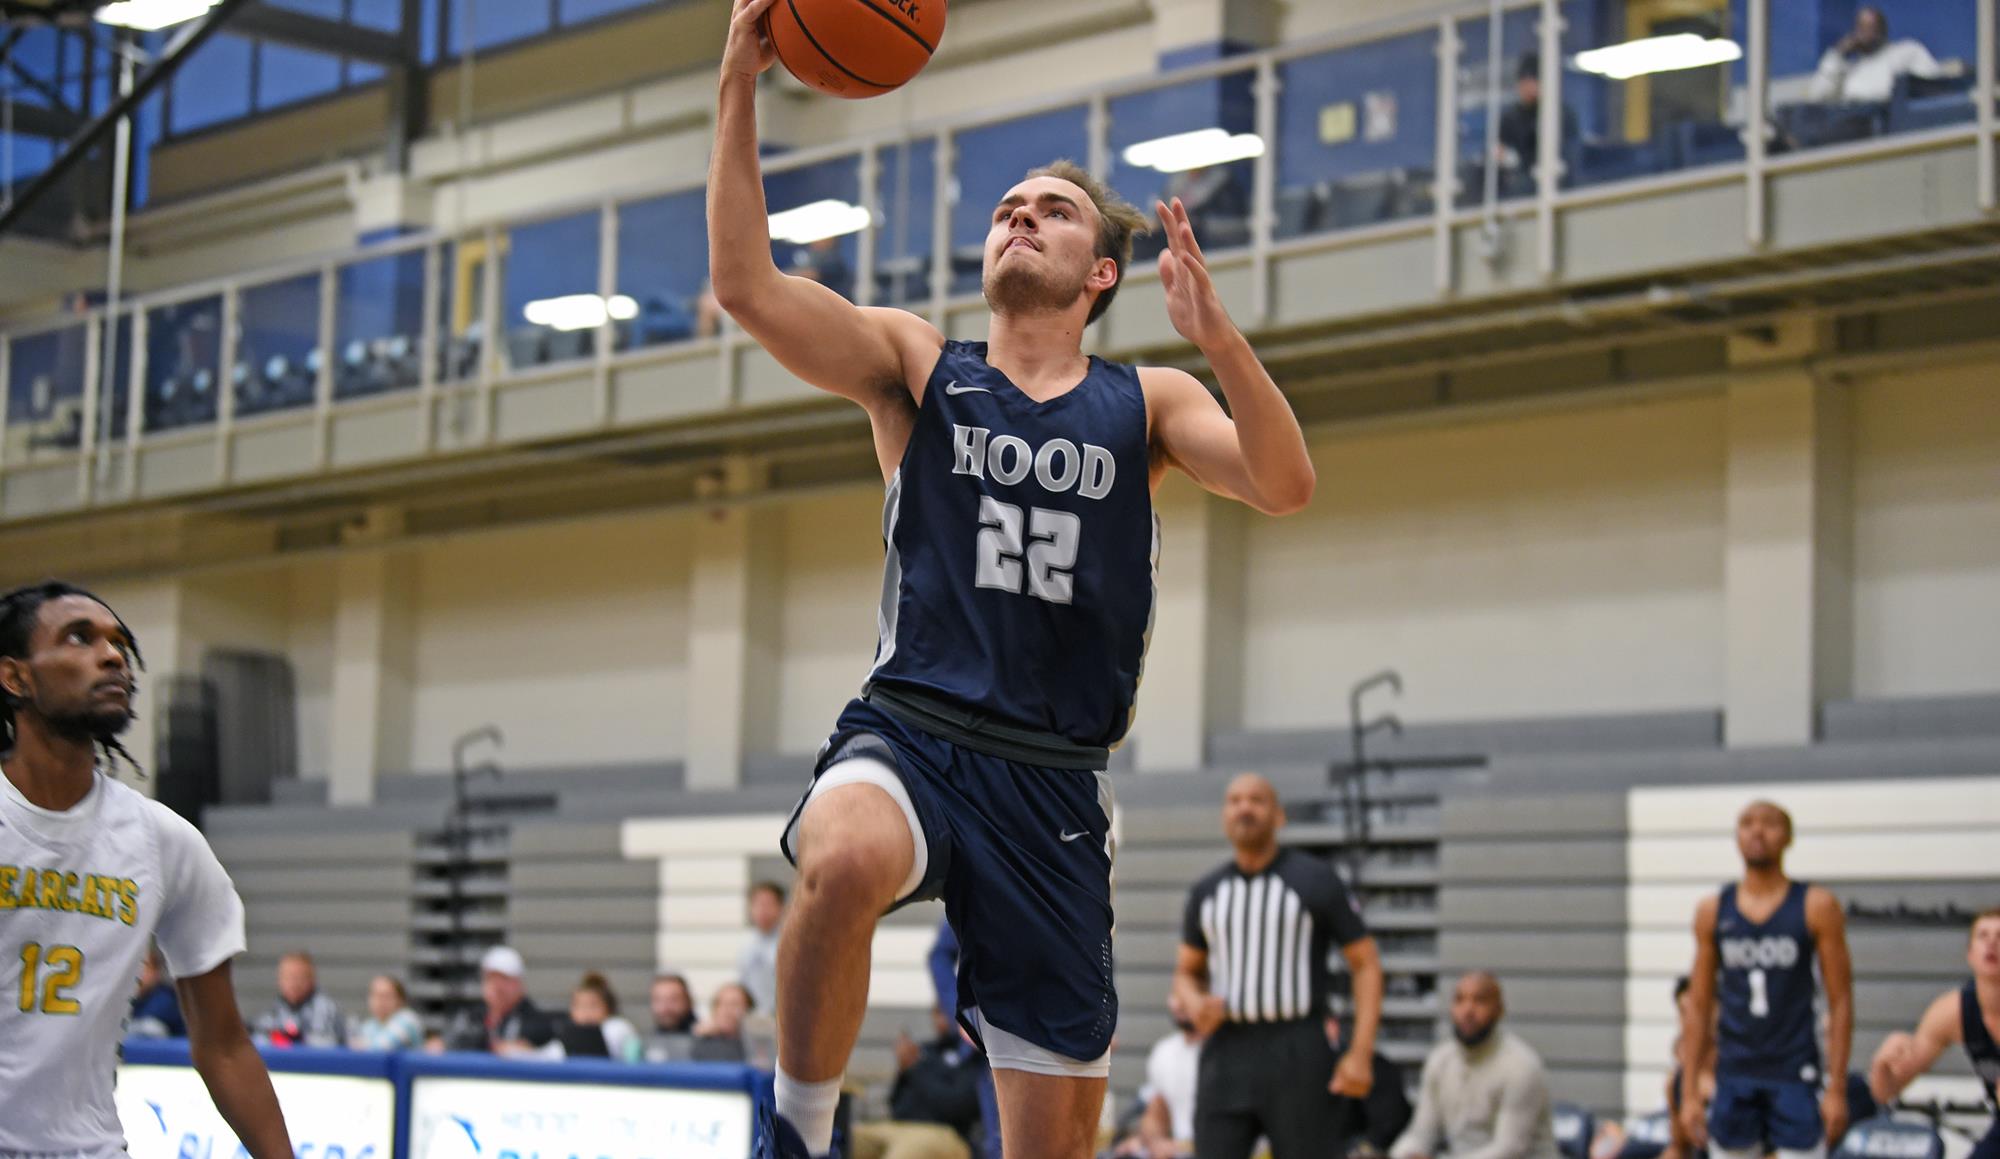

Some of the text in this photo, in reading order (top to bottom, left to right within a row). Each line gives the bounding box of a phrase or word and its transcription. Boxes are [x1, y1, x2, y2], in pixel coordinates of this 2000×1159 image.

[952, 424, 1116, 501] HOOD
[975, 494, 1081, 606] 22
[0, 866, 139, 926] EARCATS
[18, 942, 83, 1014] 12
[1748, 967, 1768, 1018] 1
